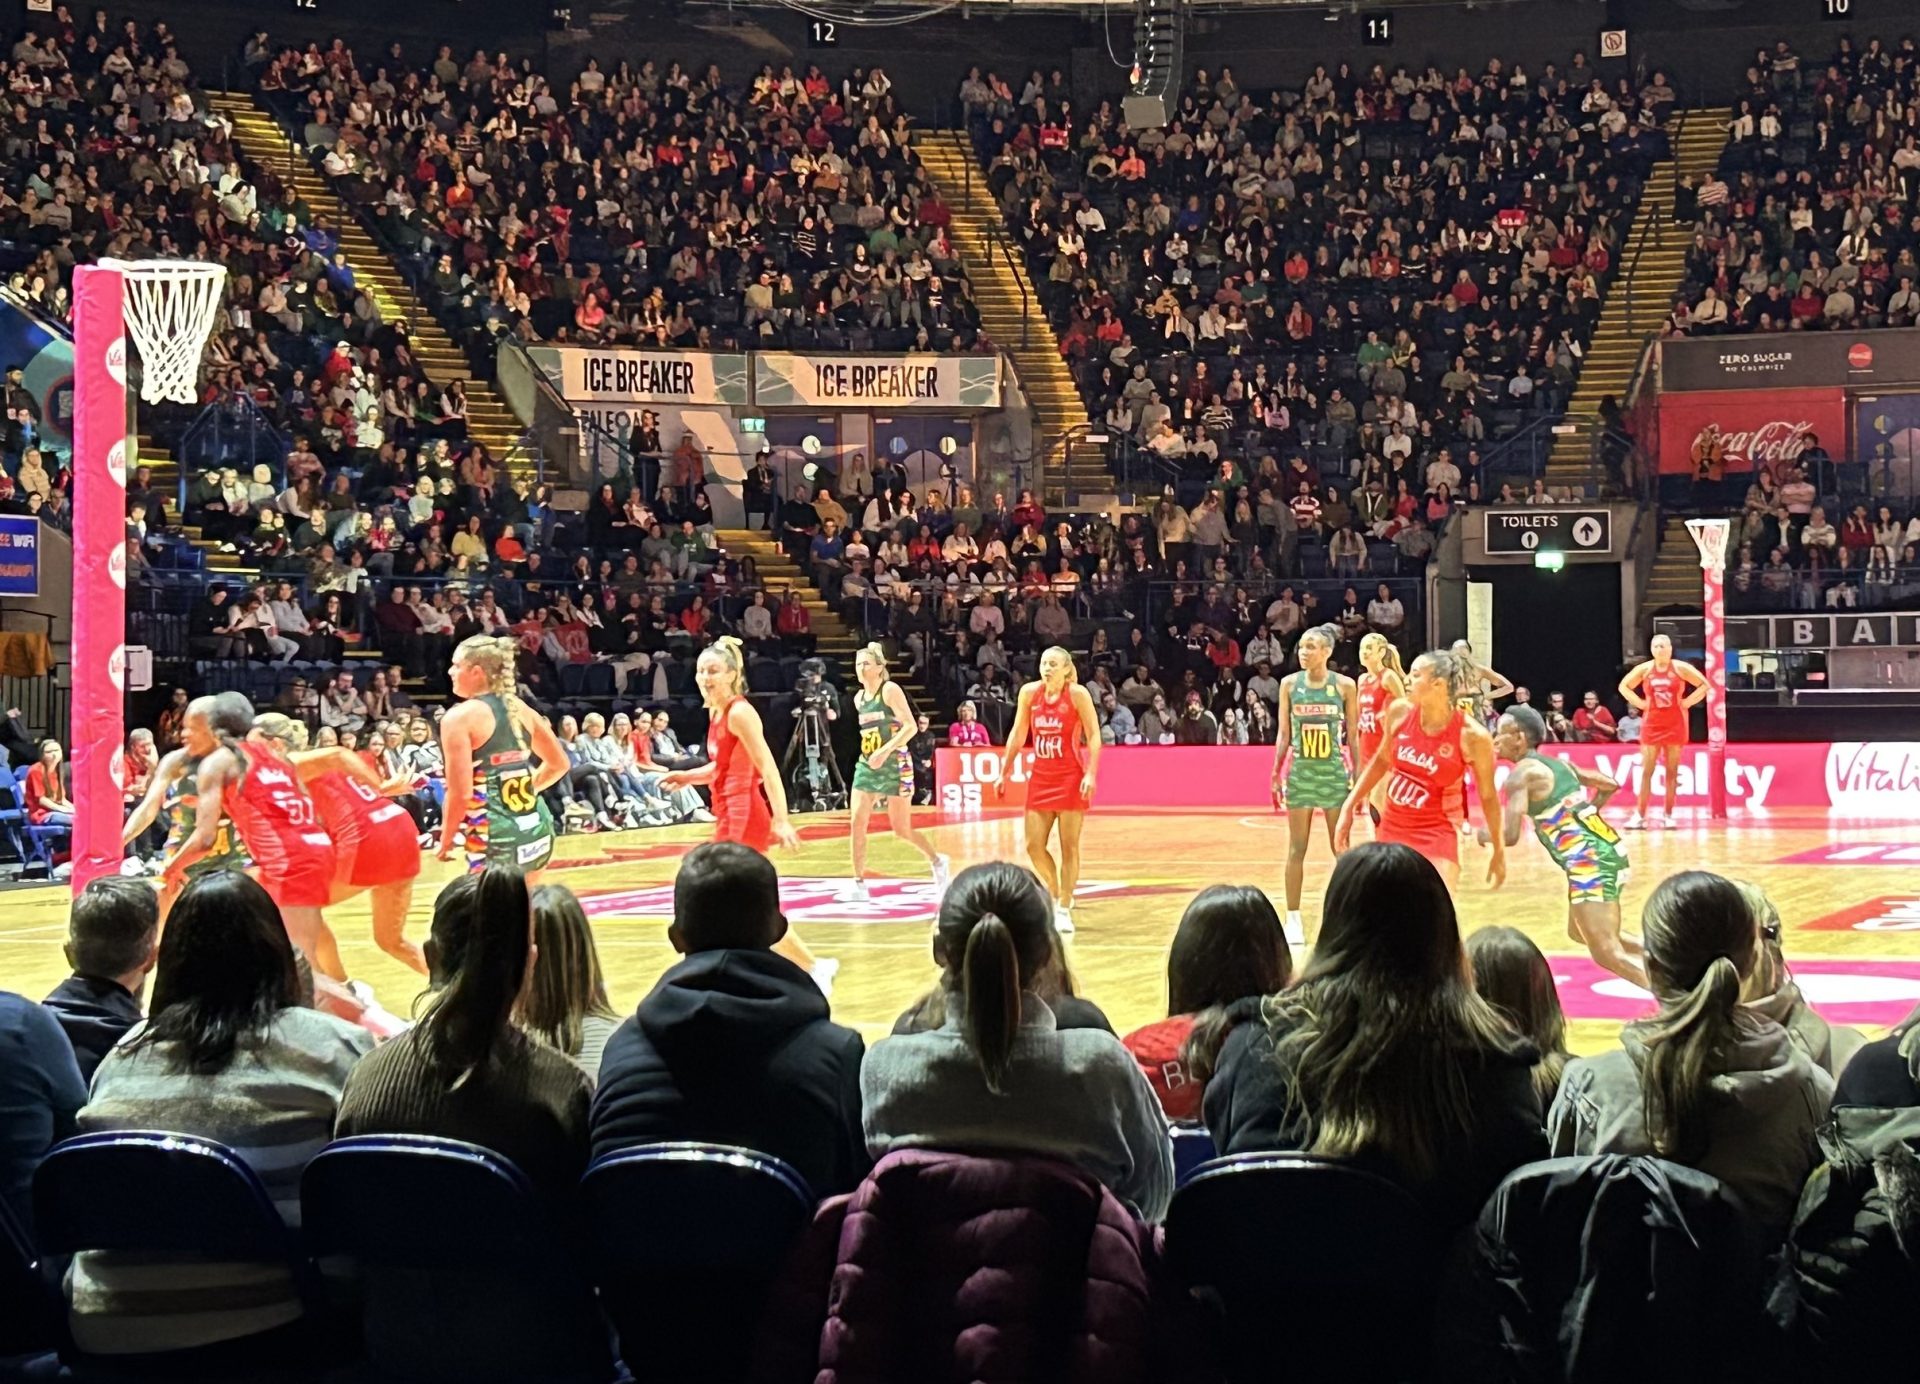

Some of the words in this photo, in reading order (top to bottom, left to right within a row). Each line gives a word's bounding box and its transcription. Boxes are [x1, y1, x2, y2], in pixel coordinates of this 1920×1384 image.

[813, 22, 835, 41] 12
[1368, 19, 1388, 38] 11
[1719, 354, 1750, 364] ZERO
[1753, 352, 1793, 363] SUGAR
[583, 357, 612, 392] ICE
[616, 360, 695, 394] BREAKER
[815, 364, 848, 397] ICE
[852, 365, 939, 398] BREAKER
[1500, 515, 1559, 528] TOILETS
[1303, 728, 1332, 759] WD
[502, 776, 536, 813] GS
[1595, 751, 1776, 809] Vitalty
